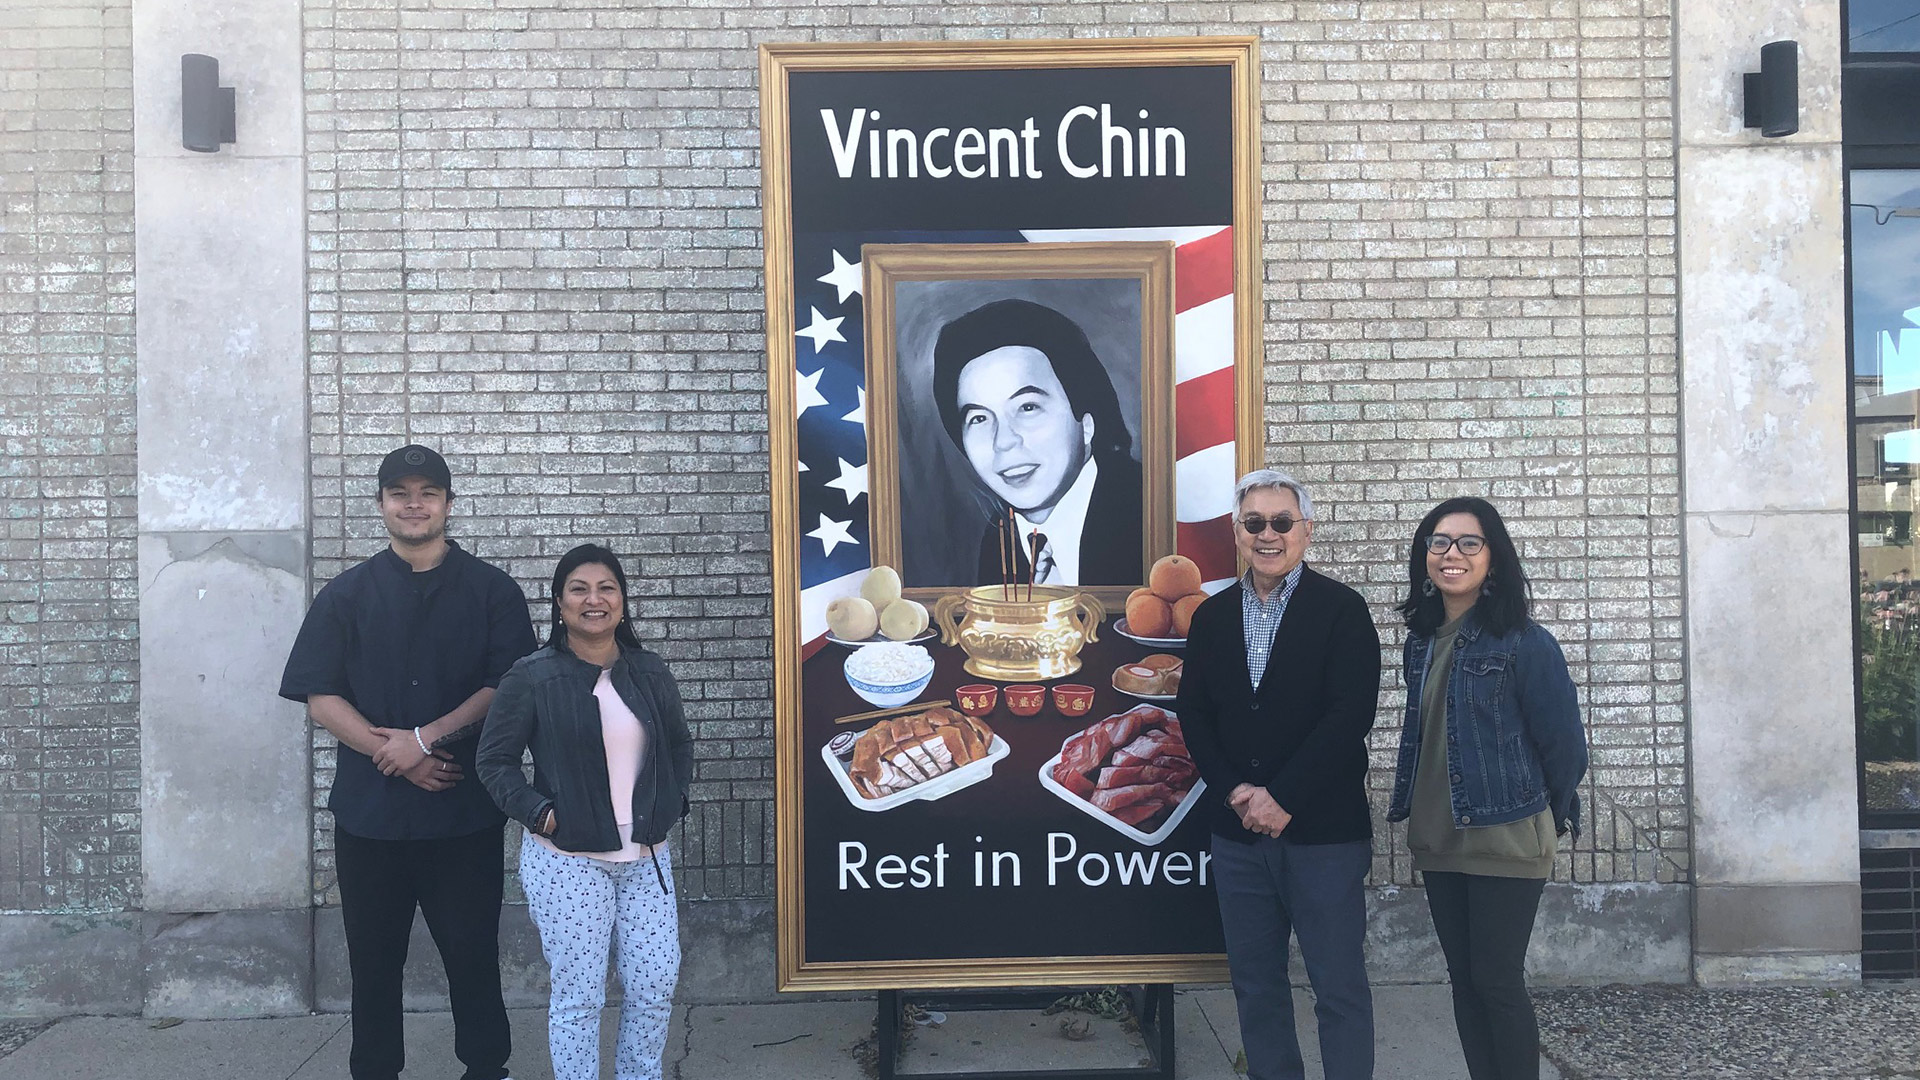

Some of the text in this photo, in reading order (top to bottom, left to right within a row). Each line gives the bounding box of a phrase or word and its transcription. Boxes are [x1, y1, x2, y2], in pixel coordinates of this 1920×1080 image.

[819, 103, 1186, 179] Vincent Chin
[838, 832, 1212, 890] Rest in Power
